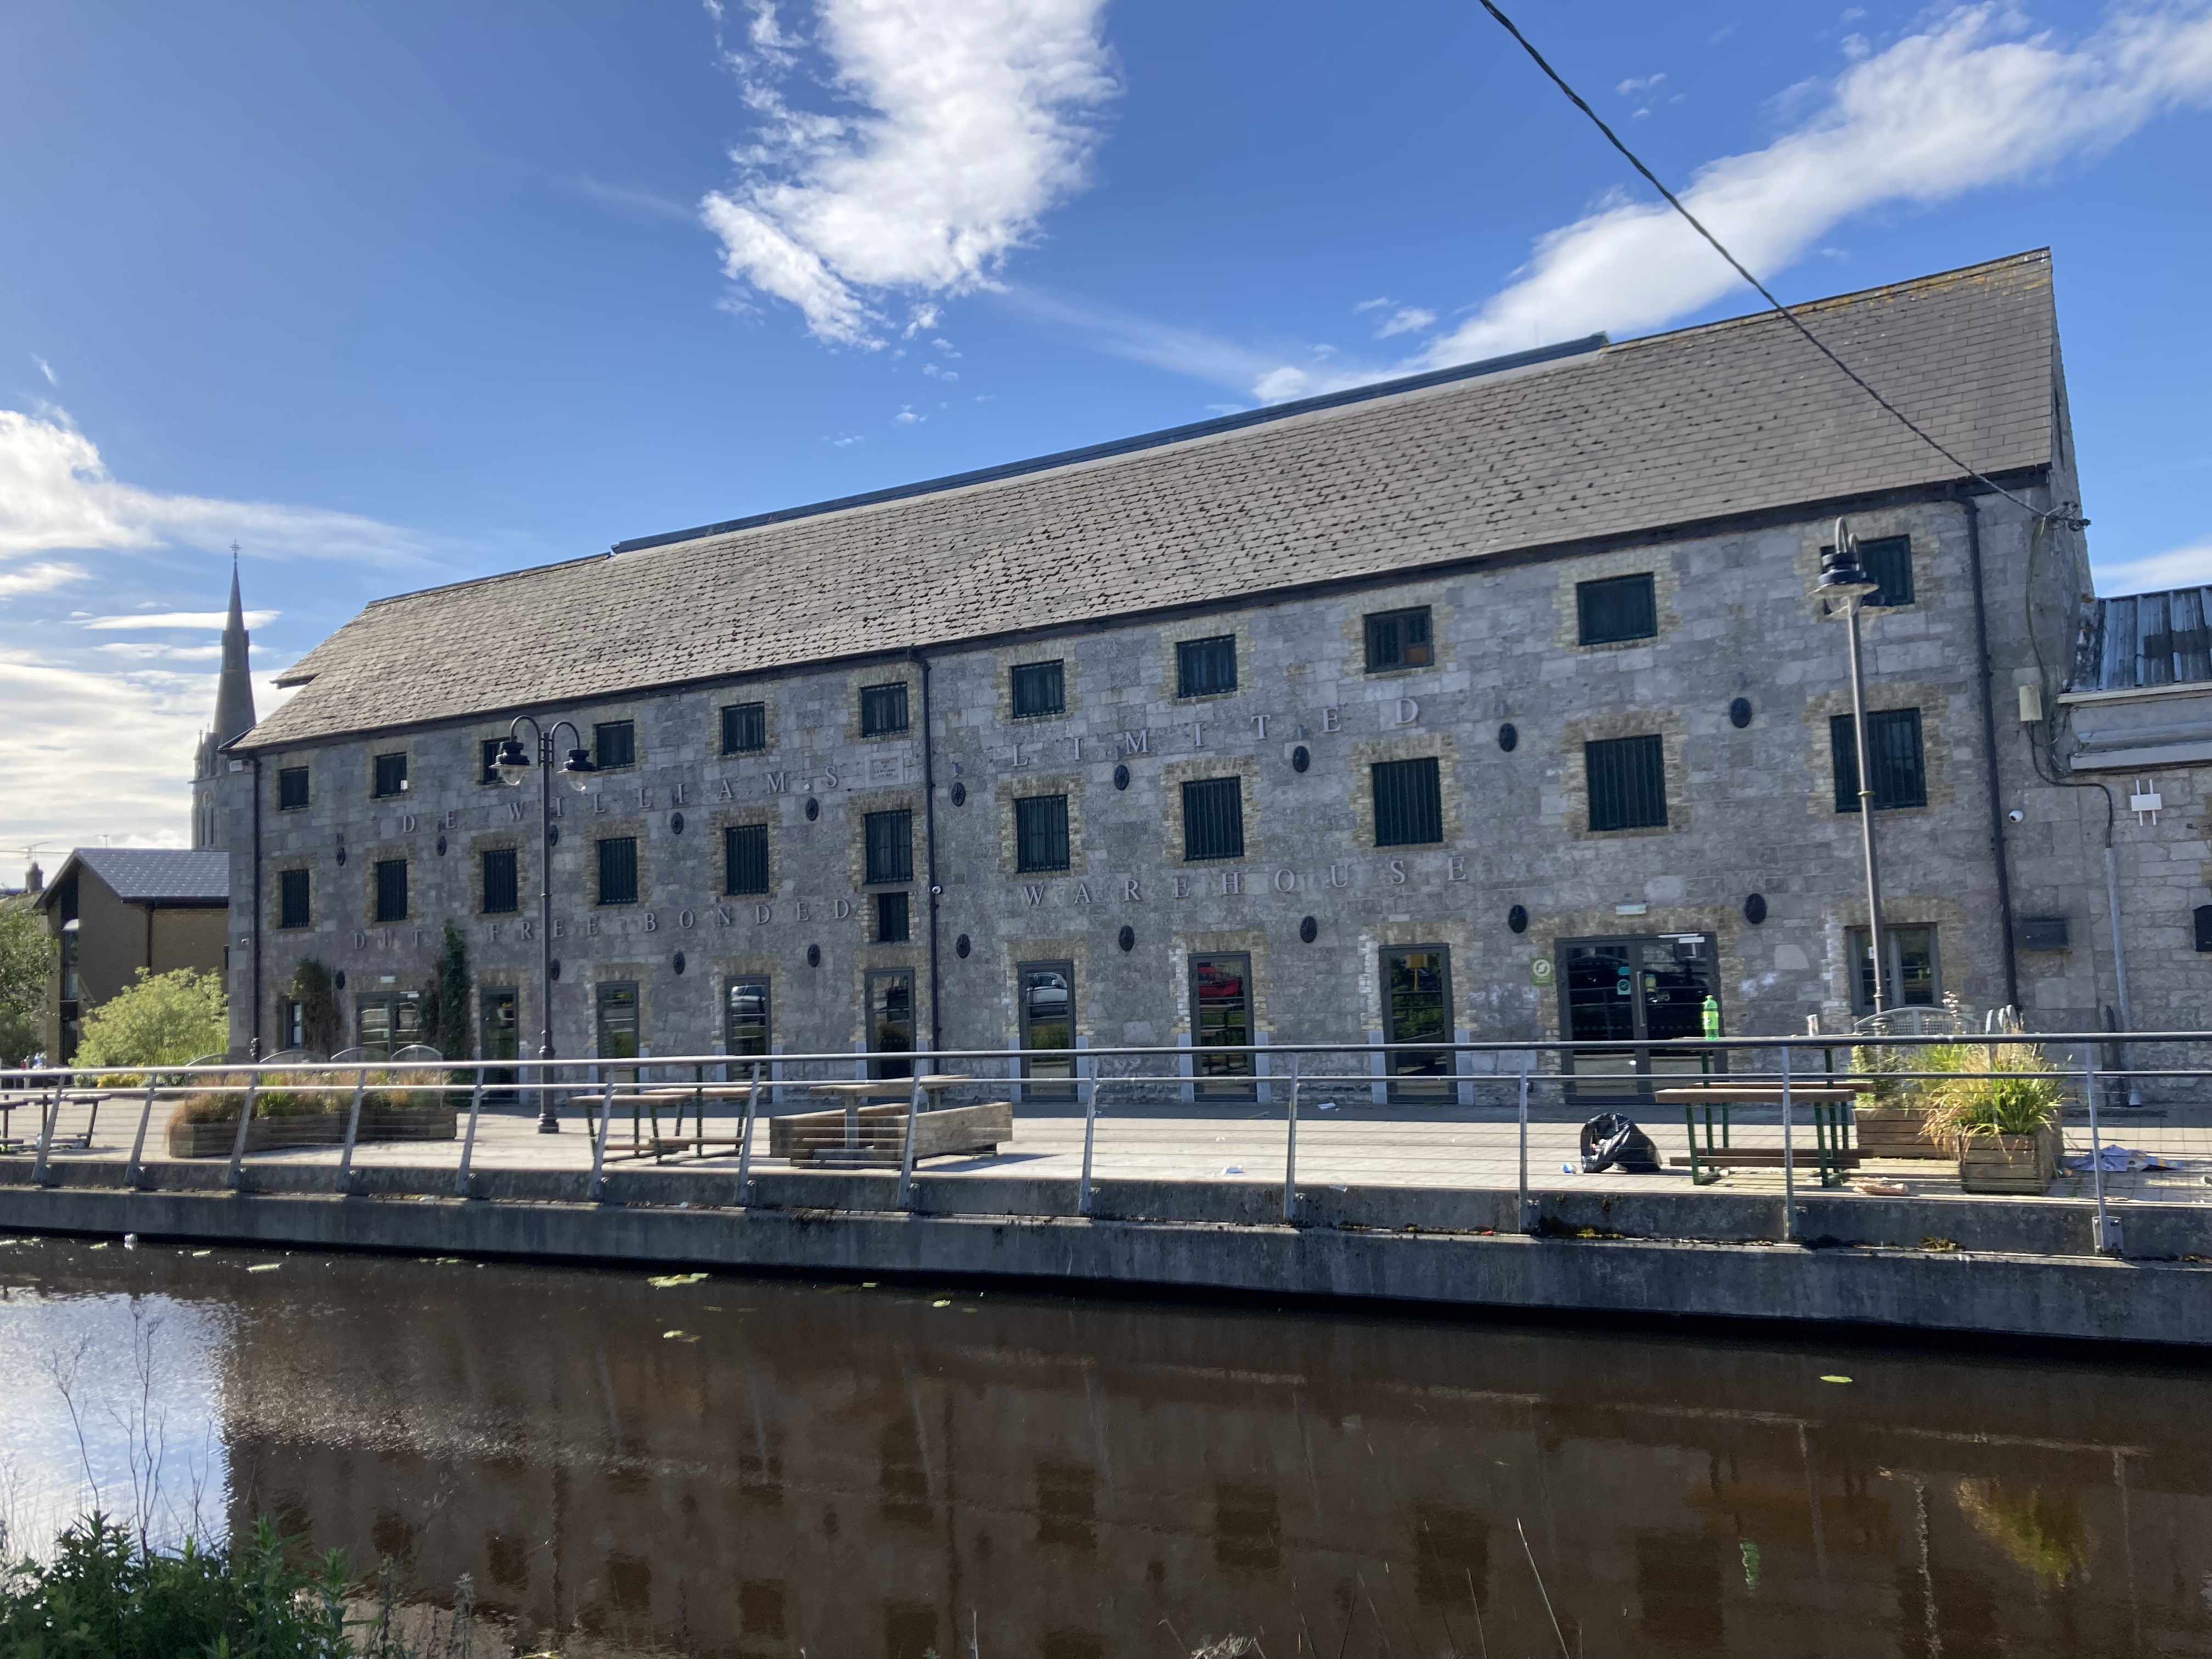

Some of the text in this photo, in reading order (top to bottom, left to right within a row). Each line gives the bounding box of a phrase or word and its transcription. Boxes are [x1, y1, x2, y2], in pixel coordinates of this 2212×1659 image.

[507, 766, 838, 821] WILLIAMS
[1012, 698, 1419, 768] LIMITED
[488, 915, 599, 940] FREE
[644, 899, 850, 932] BONDED
[1023, 855, 1467, 907] WAREHOUSE
